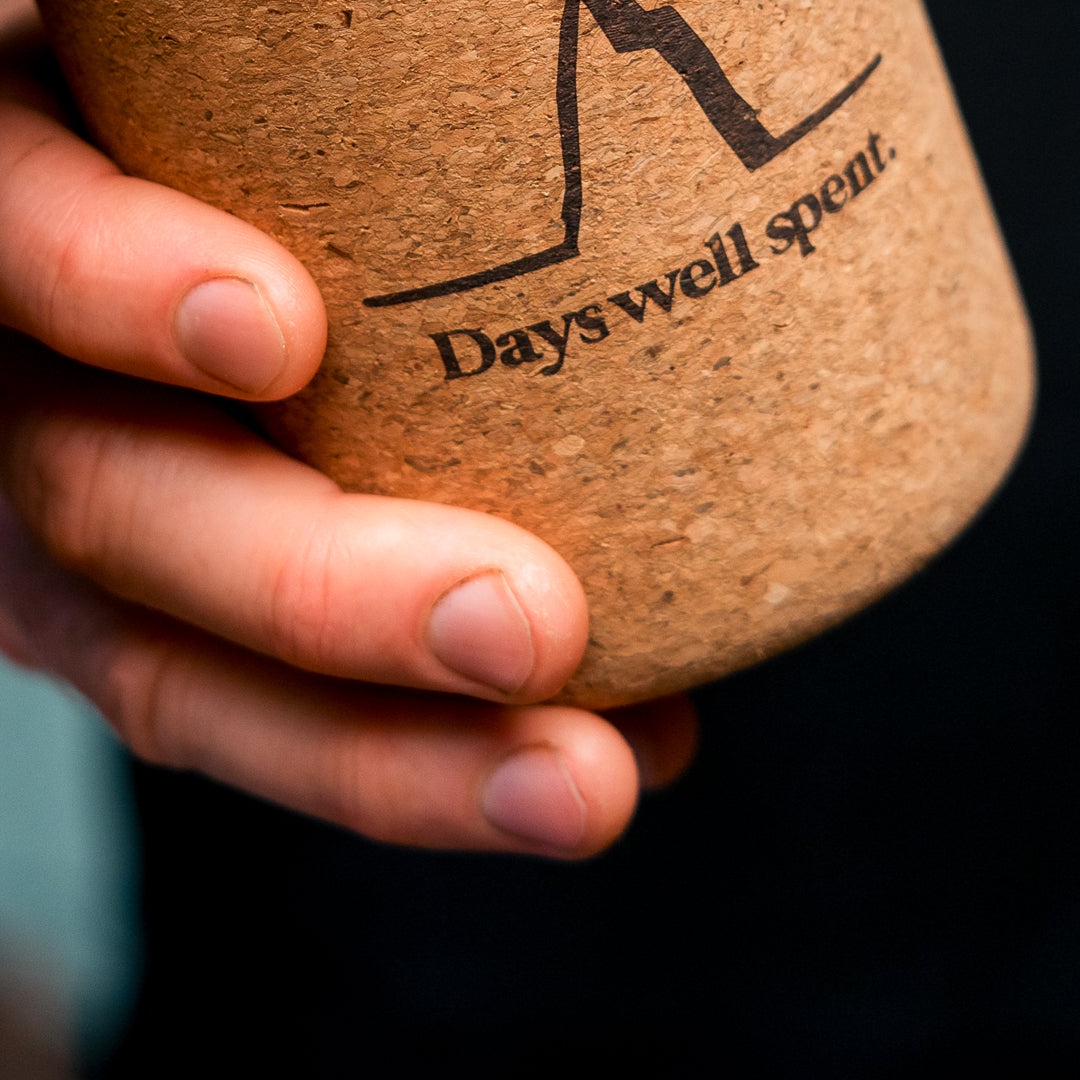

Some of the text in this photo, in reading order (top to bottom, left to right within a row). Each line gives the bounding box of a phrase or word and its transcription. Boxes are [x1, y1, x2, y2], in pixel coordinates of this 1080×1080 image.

[428, 128, 898, 380] Days well spent.
